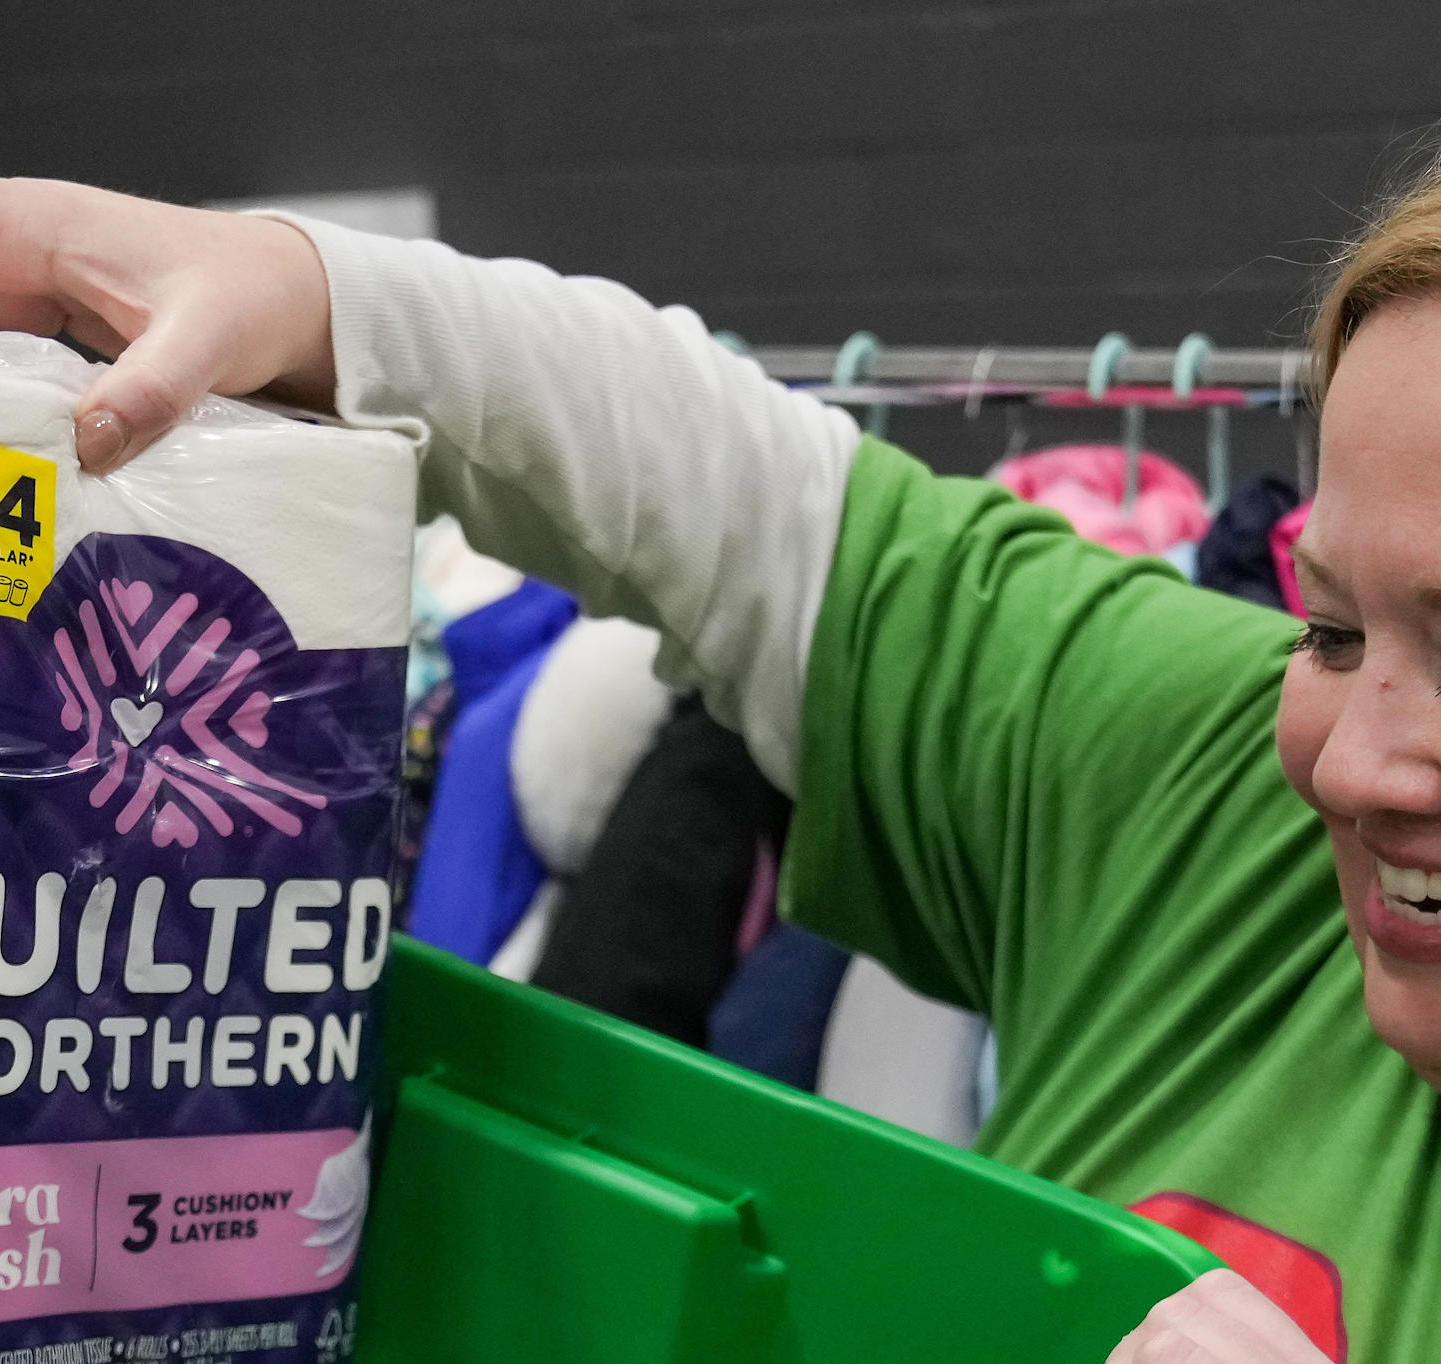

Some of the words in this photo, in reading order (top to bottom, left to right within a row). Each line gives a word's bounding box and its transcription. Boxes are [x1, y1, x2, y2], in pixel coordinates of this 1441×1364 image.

[173, 1190, 293, 1216] CUSHIONY
[122, 1193, 162, 1254] 3
[170, 1218, 259, 1244] LAYERS
[83, 1336, 114, 1364] TISSUE
